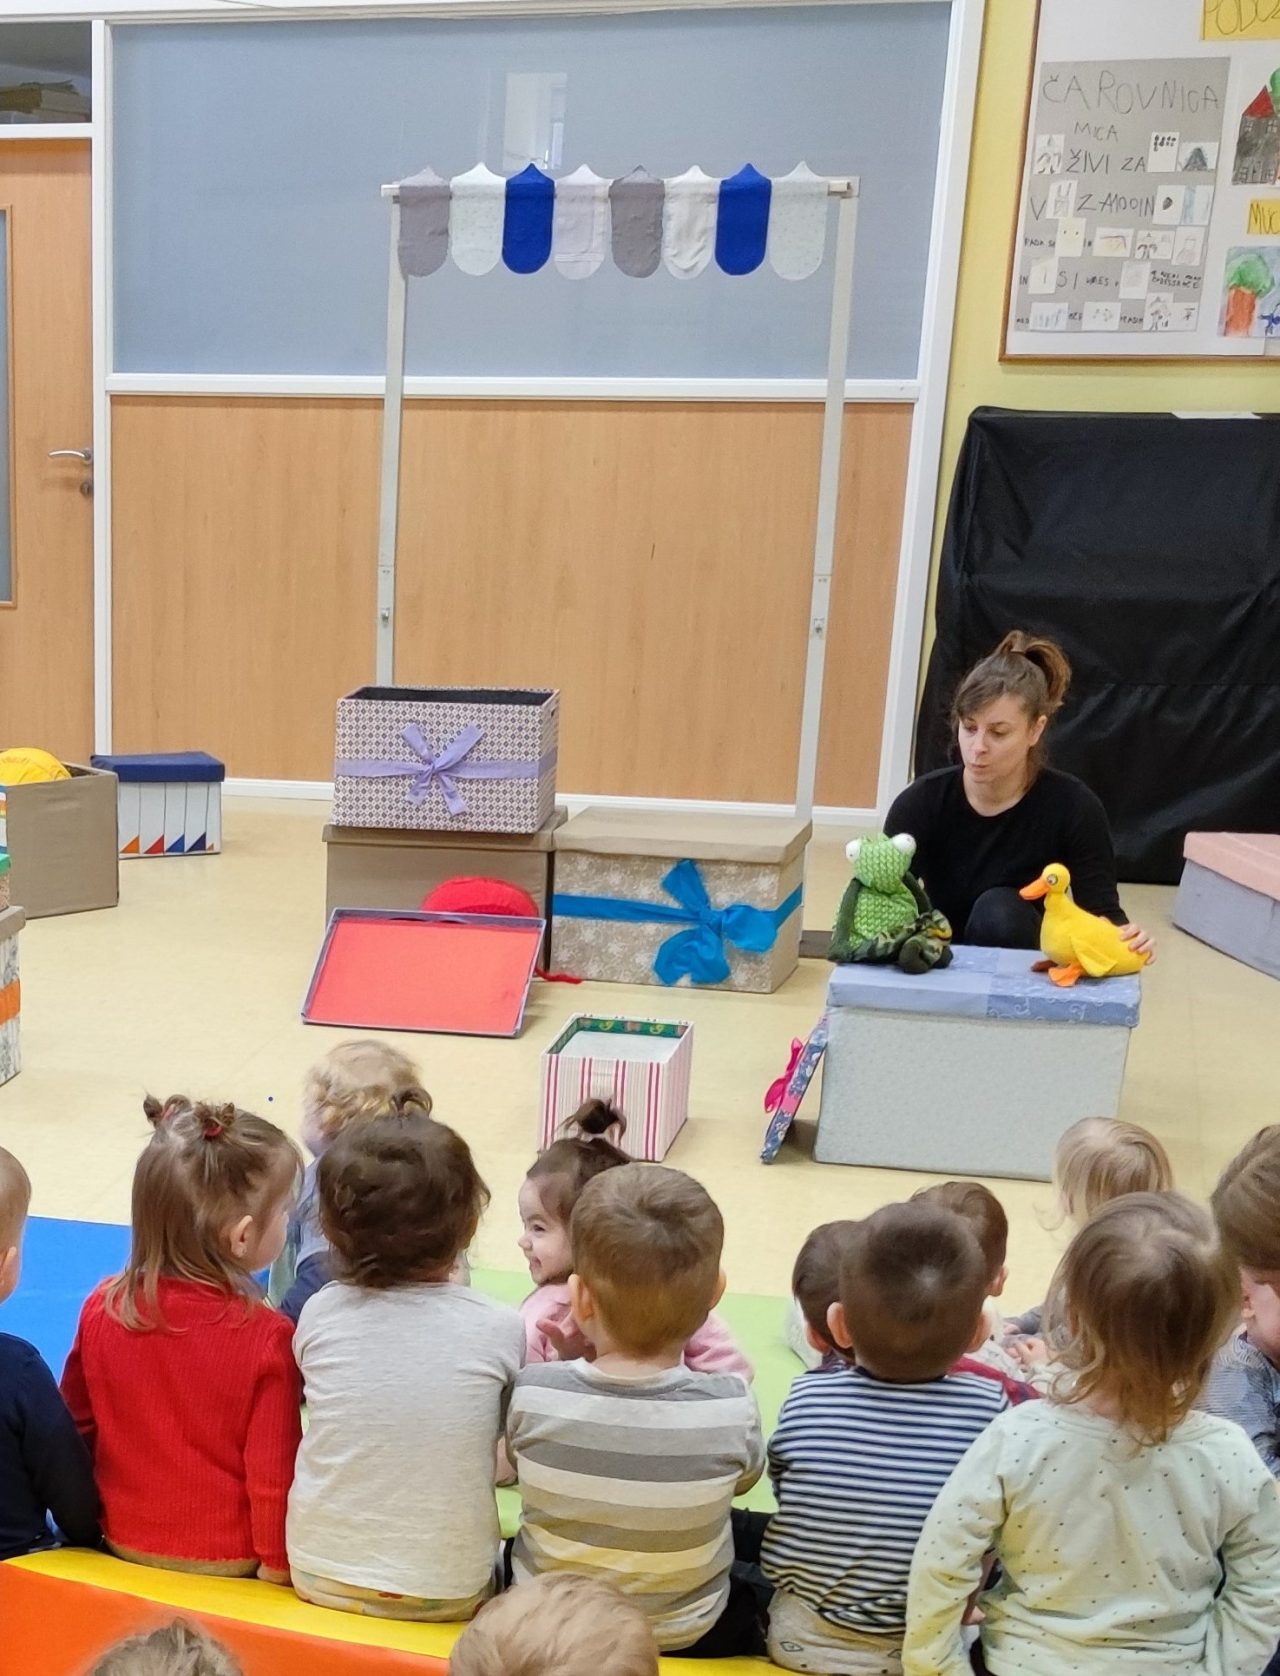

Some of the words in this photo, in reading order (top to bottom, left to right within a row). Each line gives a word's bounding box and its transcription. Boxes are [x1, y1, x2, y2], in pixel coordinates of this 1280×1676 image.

[1074, 121, 1119, 142] MICA
[1065, 148, 1110, 174] ŽIVI
[1120, 156, 1147, 173] ZA
